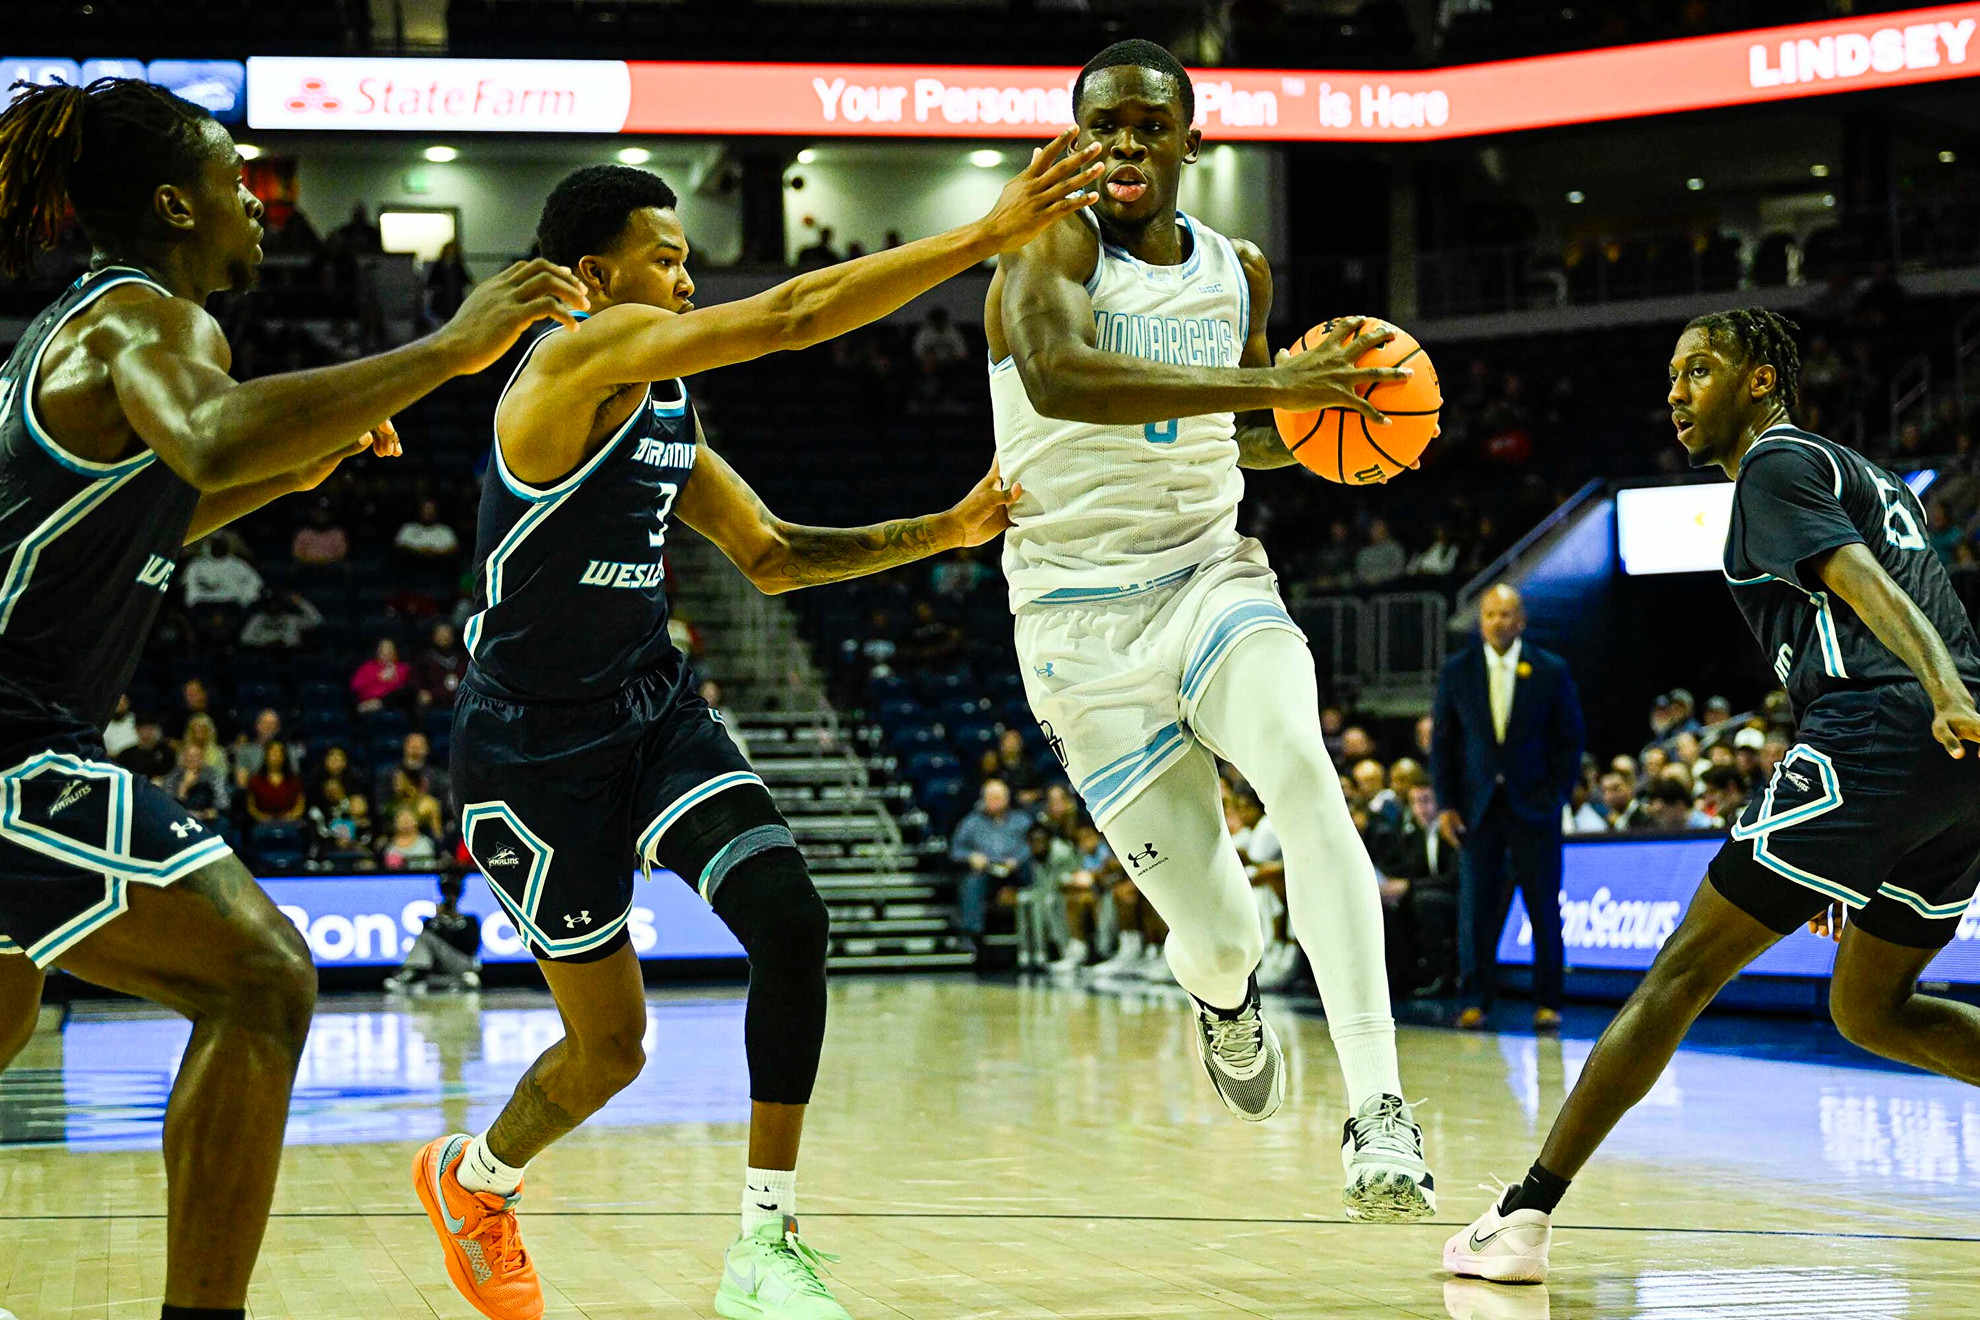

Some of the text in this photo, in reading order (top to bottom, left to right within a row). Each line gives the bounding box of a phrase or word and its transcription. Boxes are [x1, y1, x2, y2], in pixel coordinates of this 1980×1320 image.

[1750, 18, 1977, 88] LINDSEY
[812, 77, 908, 122] Your
[1319, 81, 1352, 128] is
[1360, 84, 1449, 128] Here
